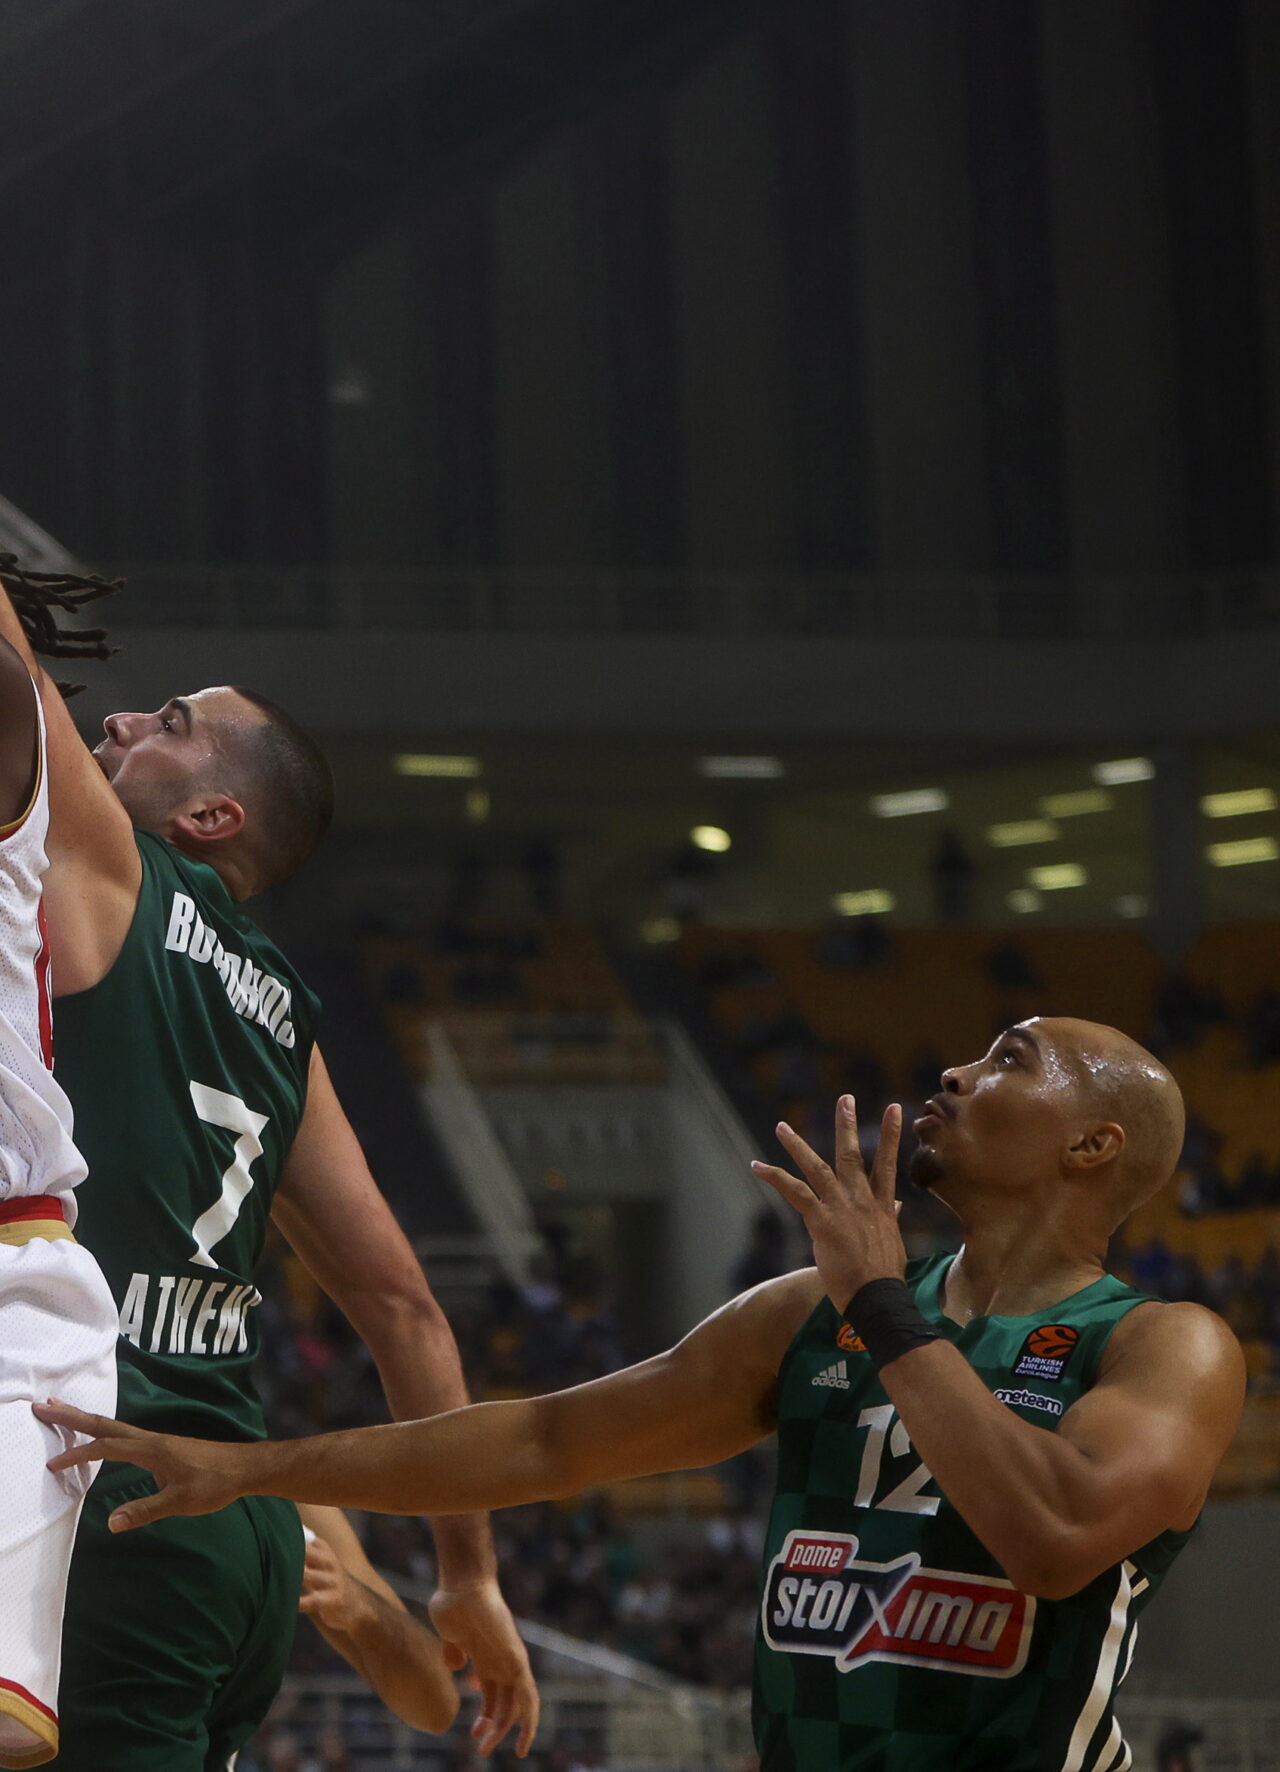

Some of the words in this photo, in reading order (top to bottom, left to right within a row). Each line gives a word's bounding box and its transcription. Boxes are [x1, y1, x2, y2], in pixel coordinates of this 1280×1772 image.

[188, 1080, 269, 1269] 7
[1018, 1362, 1062, 1374] AIRLINES
[1022, 1356, 1064, 1367] TURKISH
[811, 1376, 851, 1390] adidas
[994, 1389, 1063, 1415] oneteam
[853, 1404, 941, 1516] 12
[790, 1544, 844, 1569] pame
